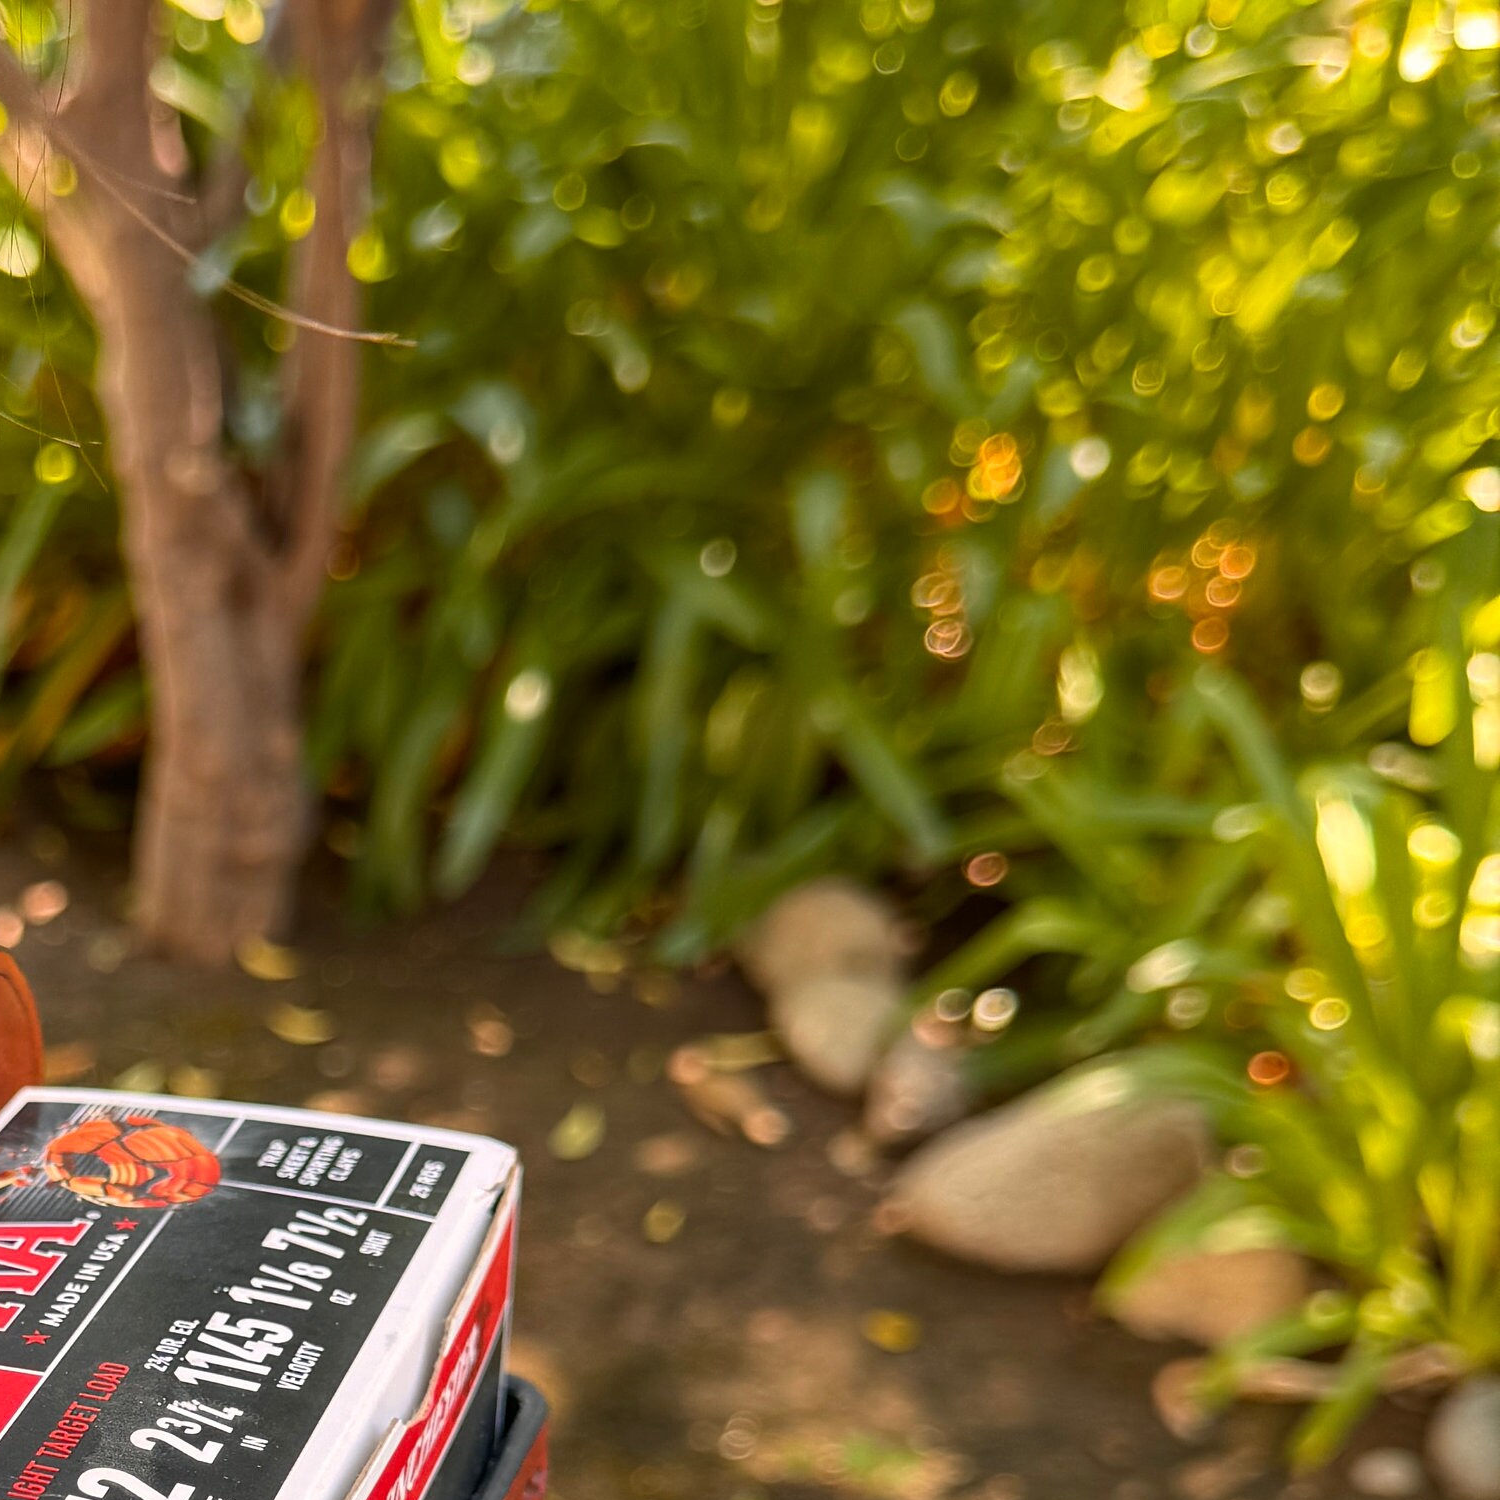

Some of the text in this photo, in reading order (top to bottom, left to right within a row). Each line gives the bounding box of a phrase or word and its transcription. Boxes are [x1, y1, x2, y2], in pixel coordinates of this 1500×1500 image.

[257, 1139, 289, 1168] TRAP
[276, 1145, 312, 1180] SKEET
[298, 1135, 345, 1187] SPORTING
[327, 1148, 363, 1182] CLAYS
[409, 1160, 446, 1199] 25 RDS
[39, 1233, 131, 1328] MADE IN USA
[174, 1311, 294, 1392] 1145
[240, 1434, 269, 1451] IN
[276, 1341, 324, 1391] VELOCITY
[329, 1289, 357, 1306] OZ
[359, 1228, 393, 1257] SHOT
[36, 1401, 101, 1459] TARGET
[78, 1361, 130, 1401] LOAD
